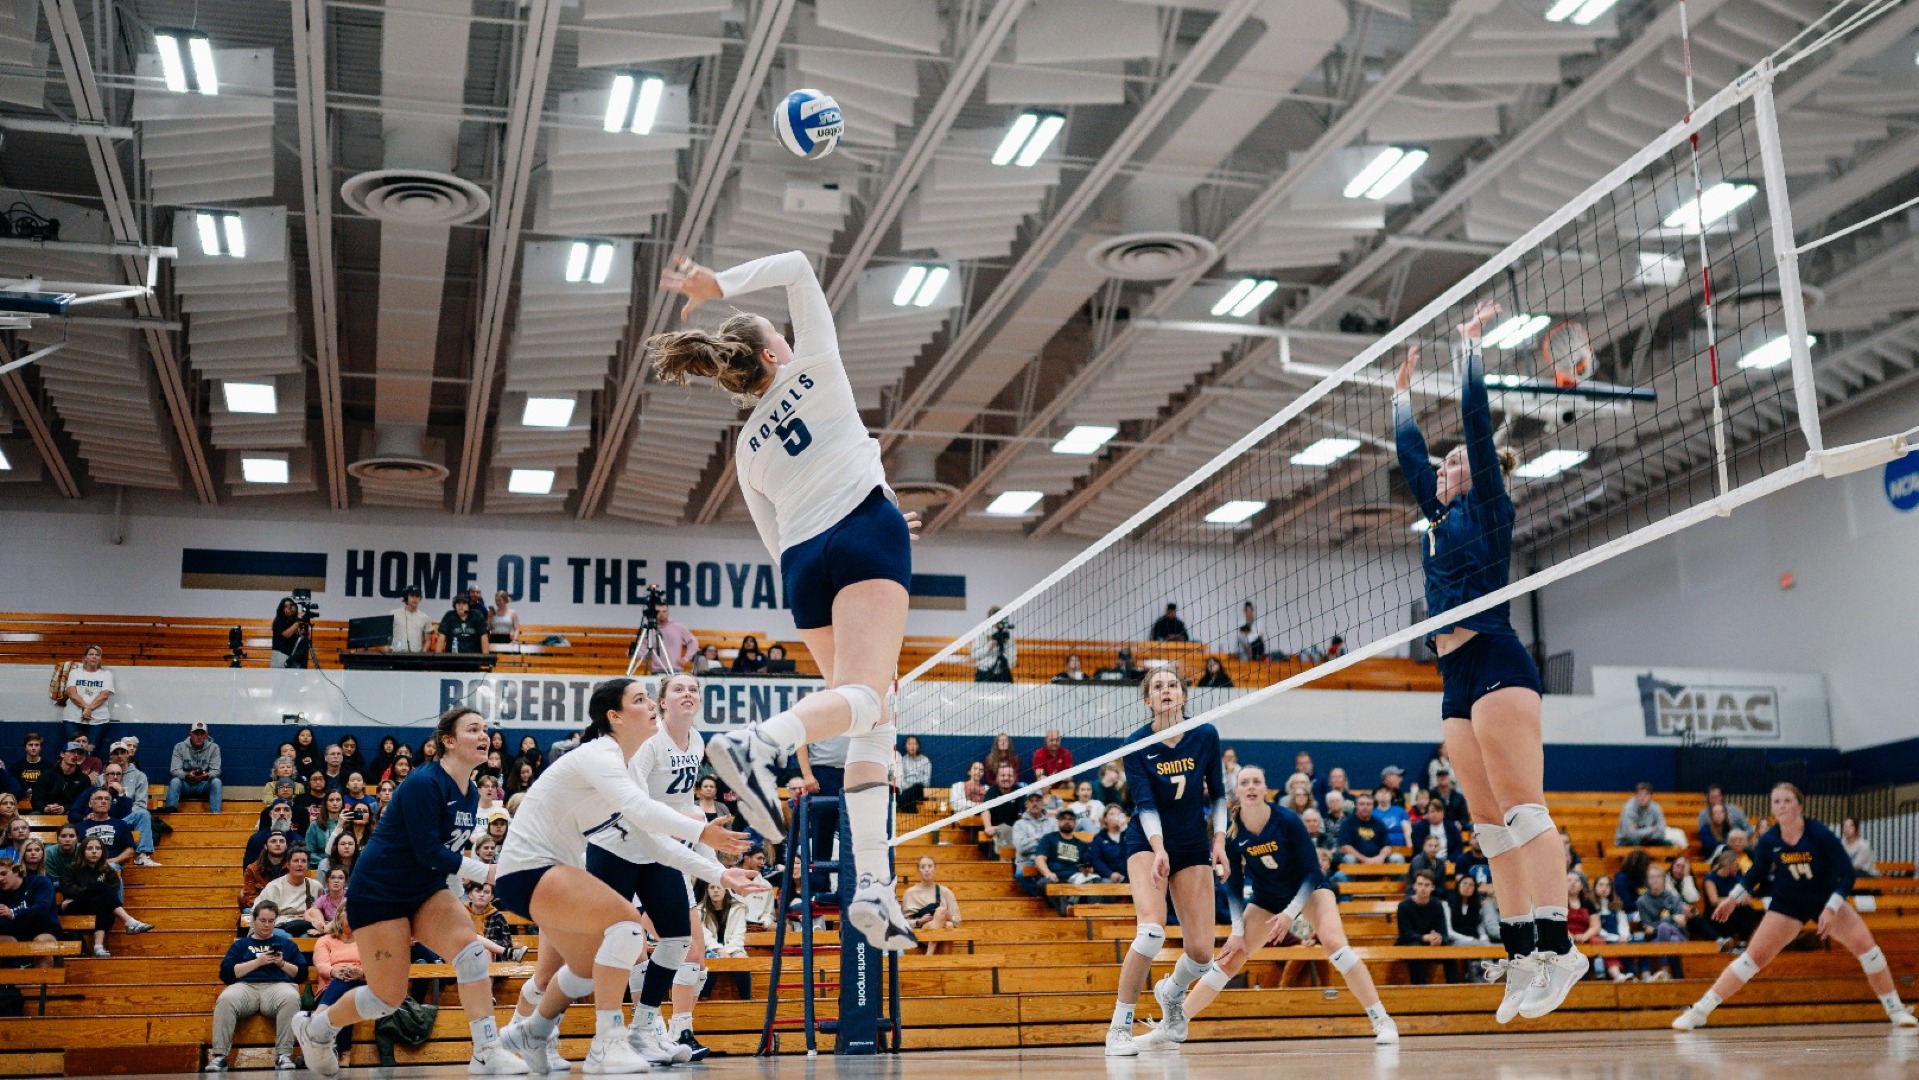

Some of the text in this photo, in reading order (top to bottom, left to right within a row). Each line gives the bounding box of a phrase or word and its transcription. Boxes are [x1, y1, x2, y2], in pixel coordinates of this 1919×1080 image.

[749, 374, 814, 452] ROYALS
[775, 417, 812, 456] 5
[345, 549, 478, 600] HOME
[497, 554, 549, 602] OF
[567, 557, 647, 604] THE
[1657, 692, 1773, 731] MIAC
[666, 766, 696, 794] 26
[1156, 757, 1195, 775] SAINTS
[1170, 775, 1186, 800] 7
[1246, 841, 1278, 857] SAINTS
[1788, 863, 1813, 880] 14
[857, 942, 867, 1006] sports imports
